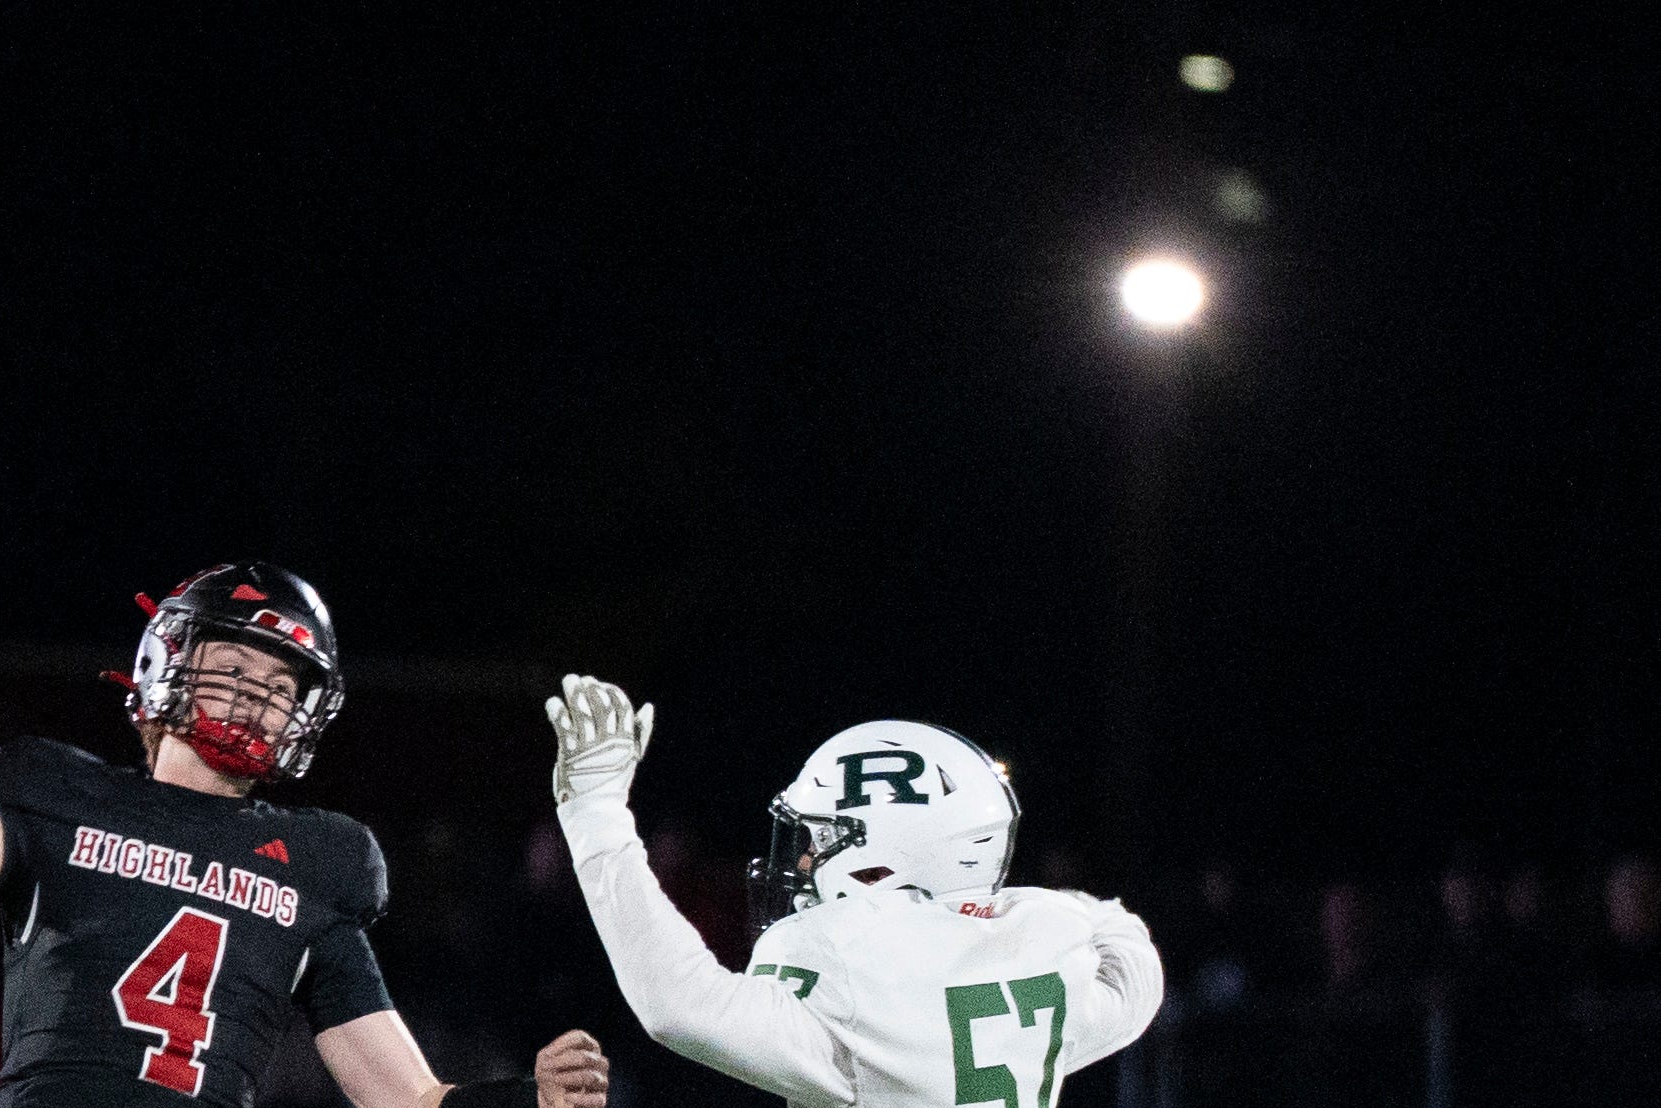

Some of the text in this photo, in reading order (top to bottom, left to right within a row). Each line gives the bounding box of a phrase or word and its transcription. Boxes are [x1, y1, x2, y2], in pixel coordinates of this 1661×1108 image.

[835, 749, 930, 811] R
[69, 826, 299, 927] HIGHLANDS
[111, 906, 230, 1098] 4
